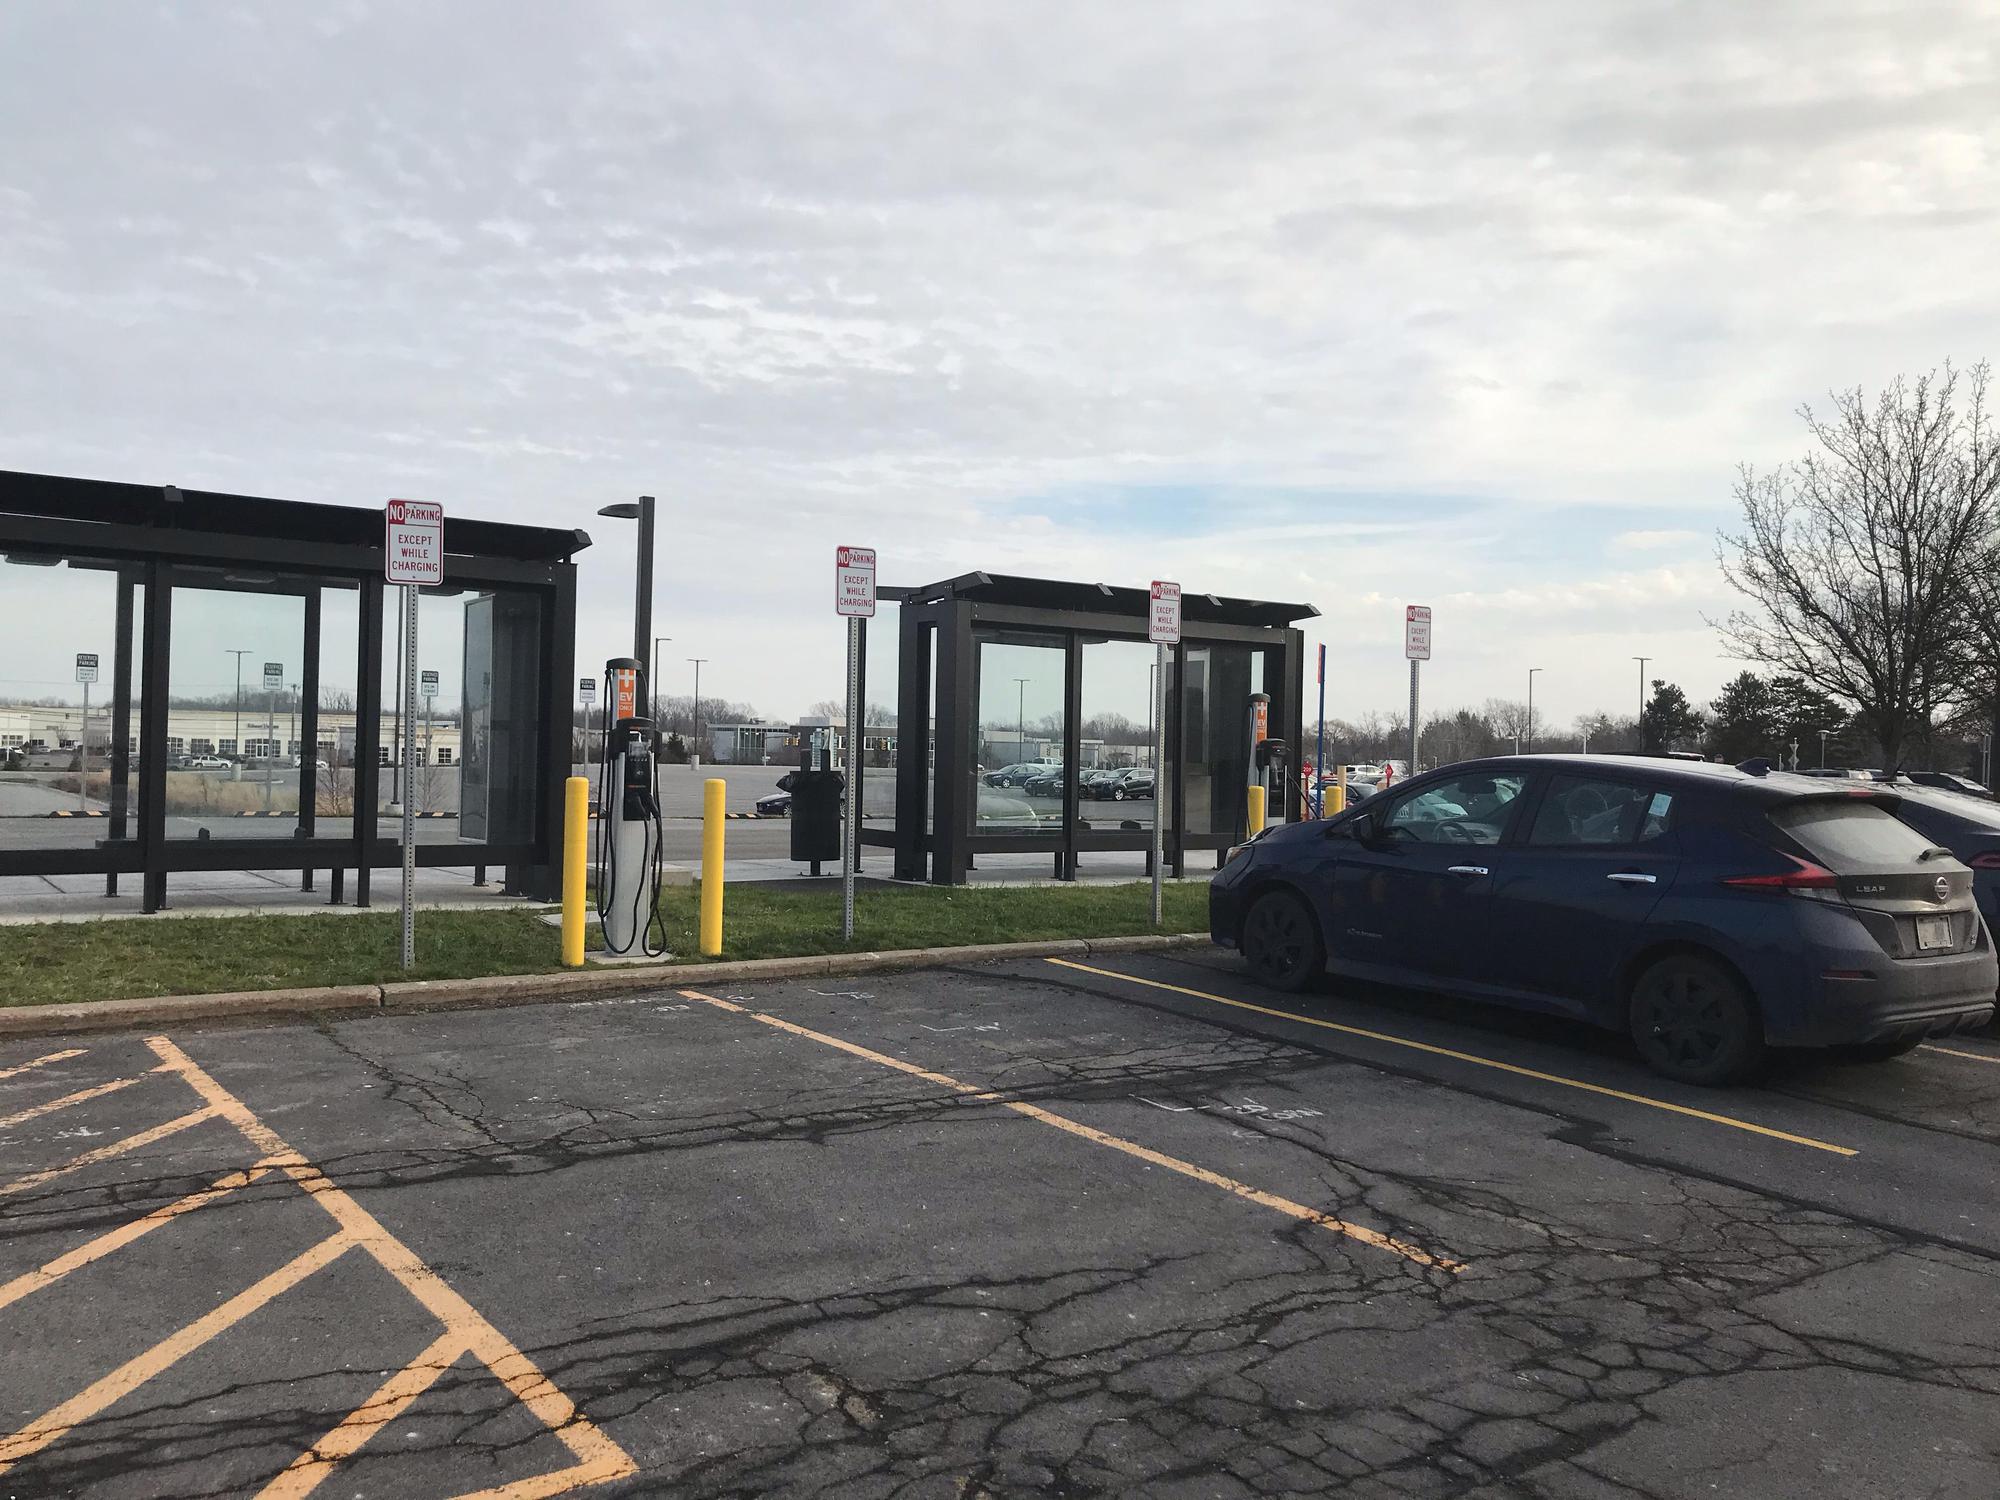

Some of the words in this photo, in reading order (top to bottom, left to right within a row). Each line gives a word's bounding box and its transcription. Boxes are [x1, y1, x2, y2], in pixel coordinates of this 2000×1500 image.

[389, 504, 404, 521] NO
[405, 508, 440, 521] PARKING
[398, 534, 432, 545] EXCEPT
[401, 547, 428, 559] WHILE
[838, 550, 849, 564] NO
[849, 553, 874, 565] PARKING
[392, 560, 438, 573] CHARGING
[844, 575, 868, 585] EXCEPT
[846, 586, 866, 596] WHILE
[1152, 584, 1160, 597] NO
[1160, 587, 1179, 597] PARKING
[840, 597, 872, 608] CHARGING
[1156, 605, 1175, 615] EXCEPT
[1157, 616, 1172, 625] WHILE
[1152, 625, 1178, 635] CHARGING
[620, 692, 633, 701] EV
[1856, 885, 1886, 893] LEAF
